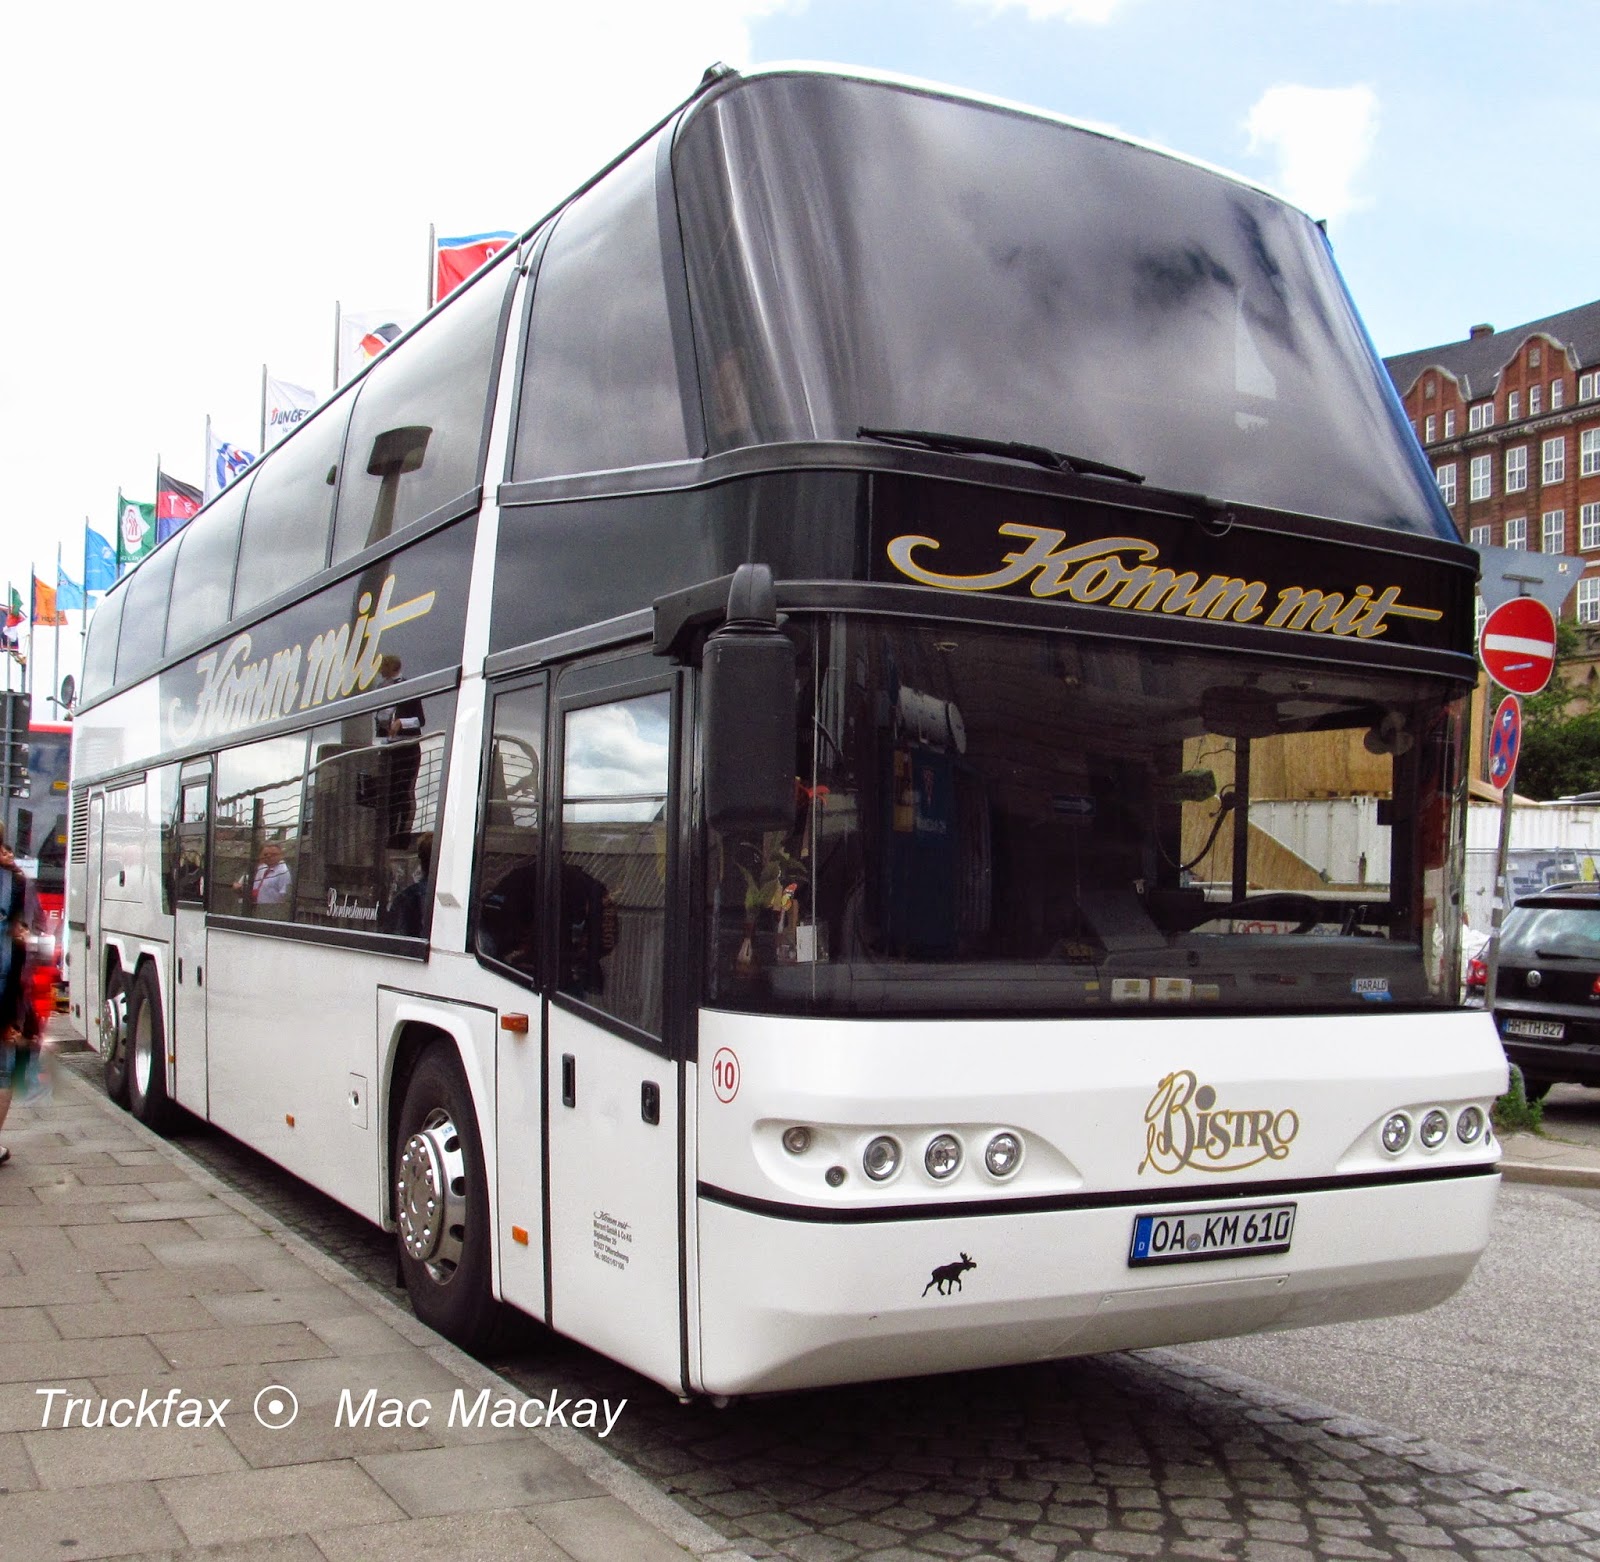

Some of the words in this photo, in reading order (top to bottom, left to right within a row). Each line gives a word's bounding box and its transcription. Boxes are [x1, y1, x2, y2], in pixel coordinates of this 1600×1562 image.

[887, 522, 1266, 621] Komm
[1264, 585, 1443, 638] mit
[168, 633, 301, 748] Komm
[300, 574, 436, 709] mit
[1356, 979, 1388, 991] HARALD
[1542, 1023, 1564, 1037] 827
[715, 1060, 735, 1089] 10
[1138, 1242, 1145, 1251] D
[1152, 1219, 1185, 1252] OA
[1203, 1215, 1239, 1247] KM
[1243, 1211, 1290, 1243] 610
